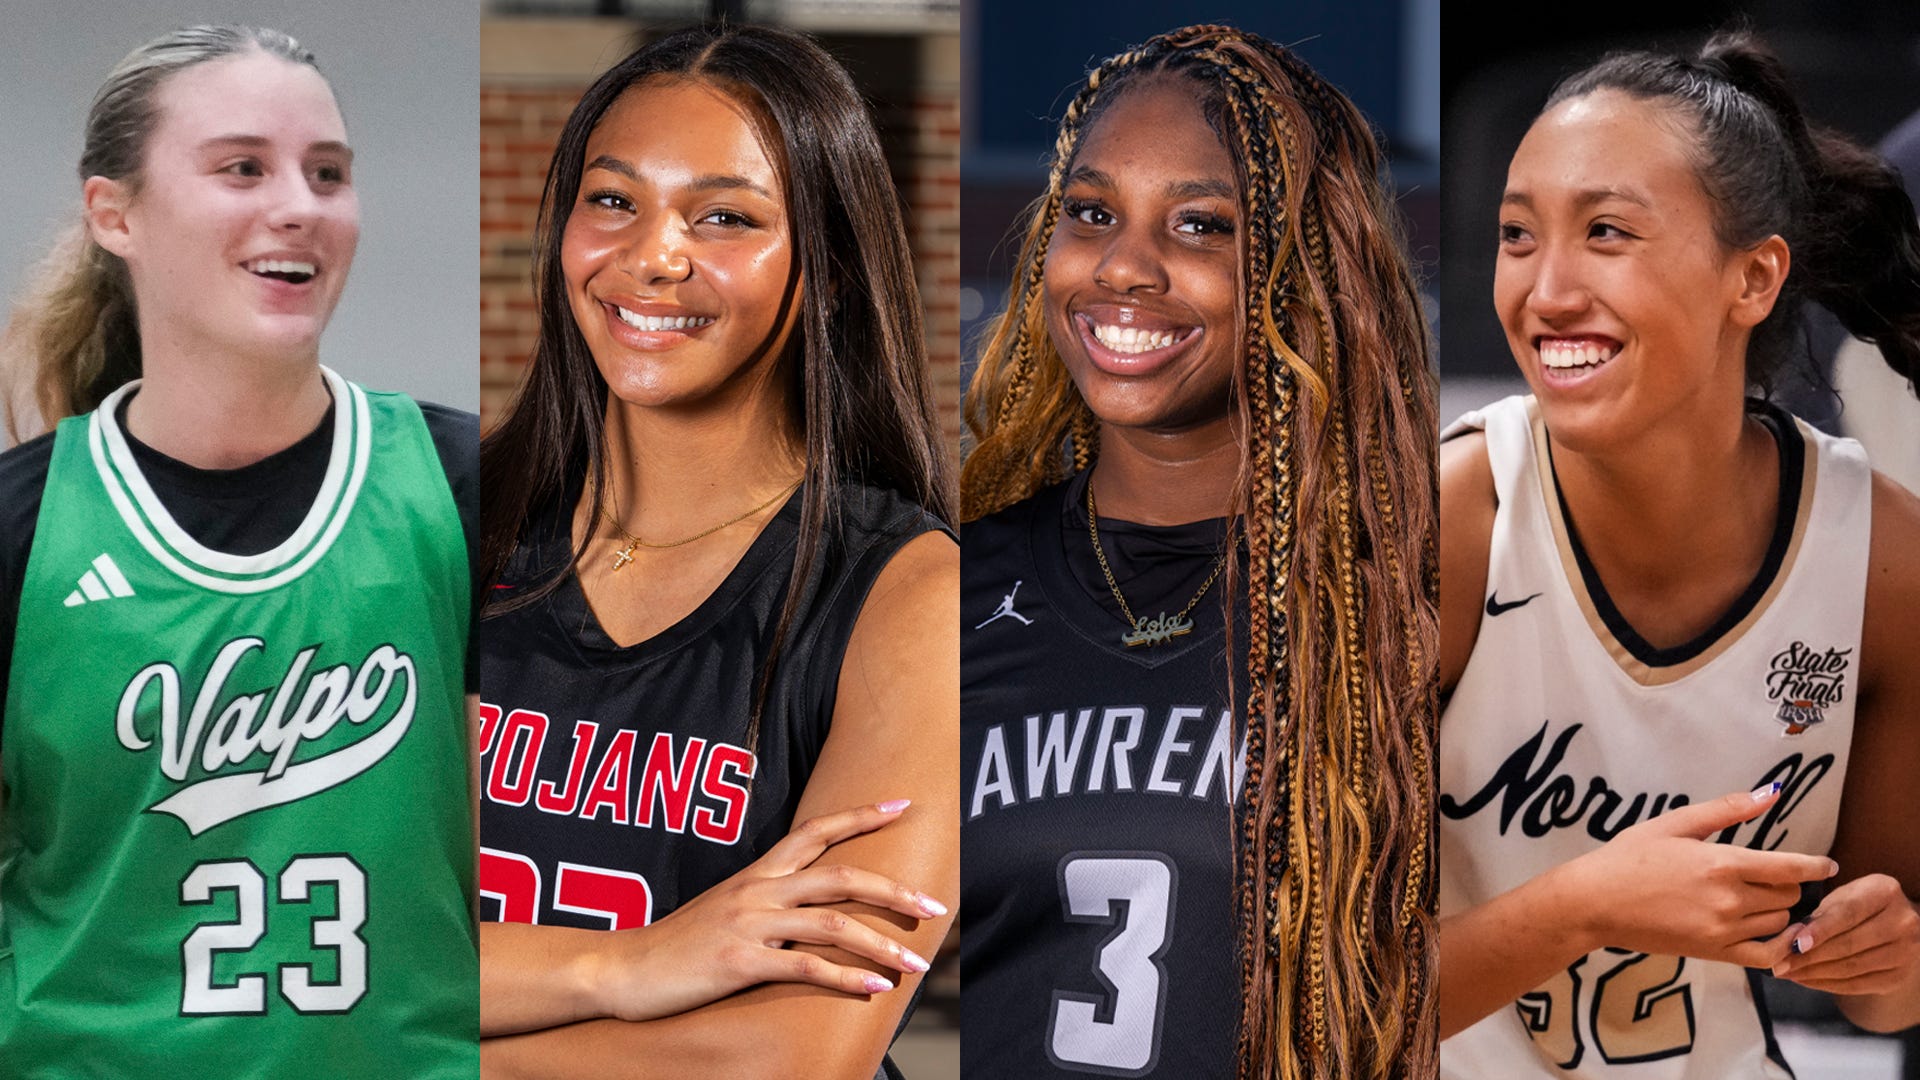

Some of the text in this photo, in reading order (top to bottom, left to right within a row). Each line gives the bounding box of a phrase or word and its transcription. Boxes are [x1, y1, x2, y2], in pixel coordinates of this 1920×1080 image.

[1126, 611, 1190, 644] Lola
[1770, 641, 1852, 675] State
[115, 636, 418, 838] Valpo
[1766, 670, 1845, 708] Finals
[178, 852, 369, 1017] 23
[1045, 850, 1179, 1078] 3
